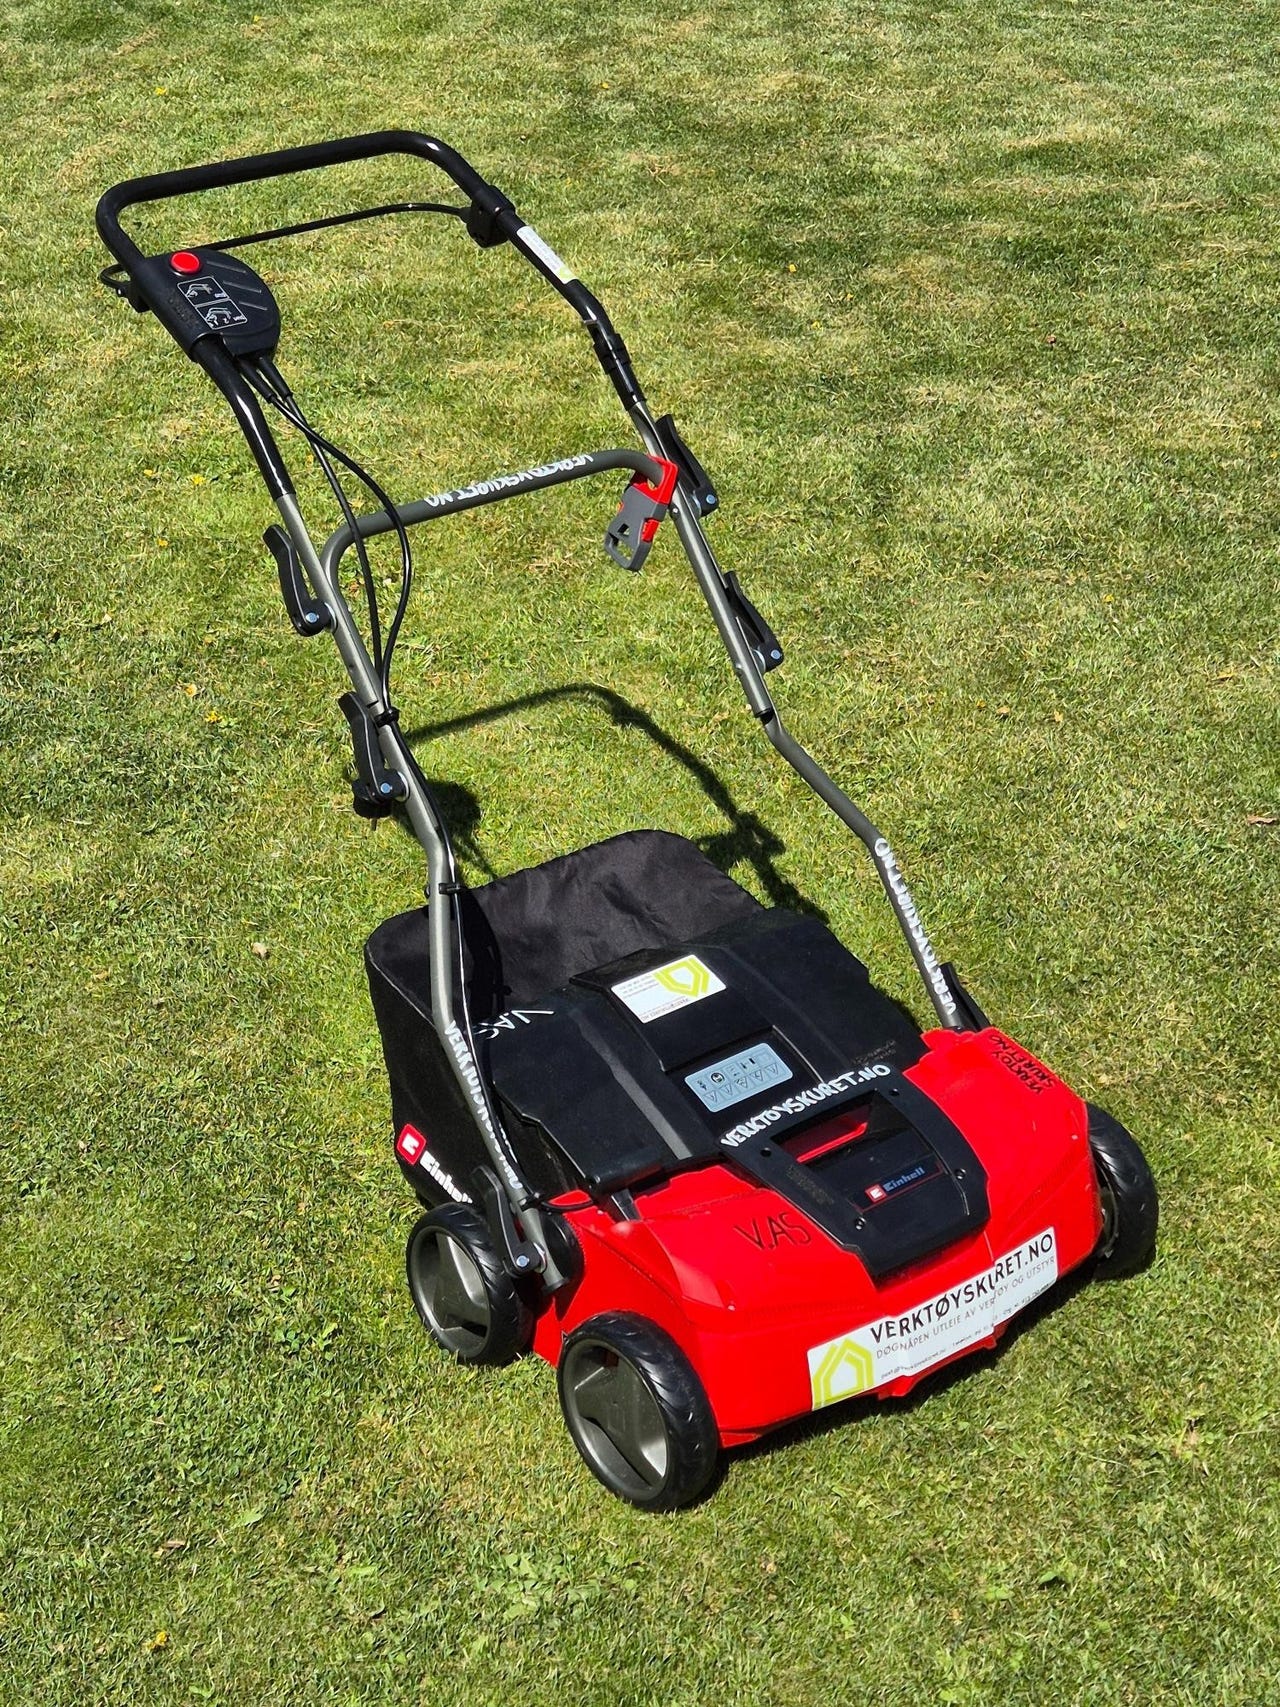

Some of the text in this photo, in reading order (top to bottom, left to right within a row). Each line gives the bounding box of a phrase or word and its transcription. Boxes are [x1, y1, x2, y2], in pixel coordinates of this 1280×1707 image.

[882, 1166, 926, 1192] Einhell
[733, 1211, 811, 1250] V.AS
[876, 1332, 930, 1359] DØGNÅPEN
[932, 1314, 961, 1336] UTLEIE
[964, 1307, 976, 1320] AV
[1011, 1276, 1024, 1289] OG
[1026, 1256, 1055, 1280] UTSTYR
